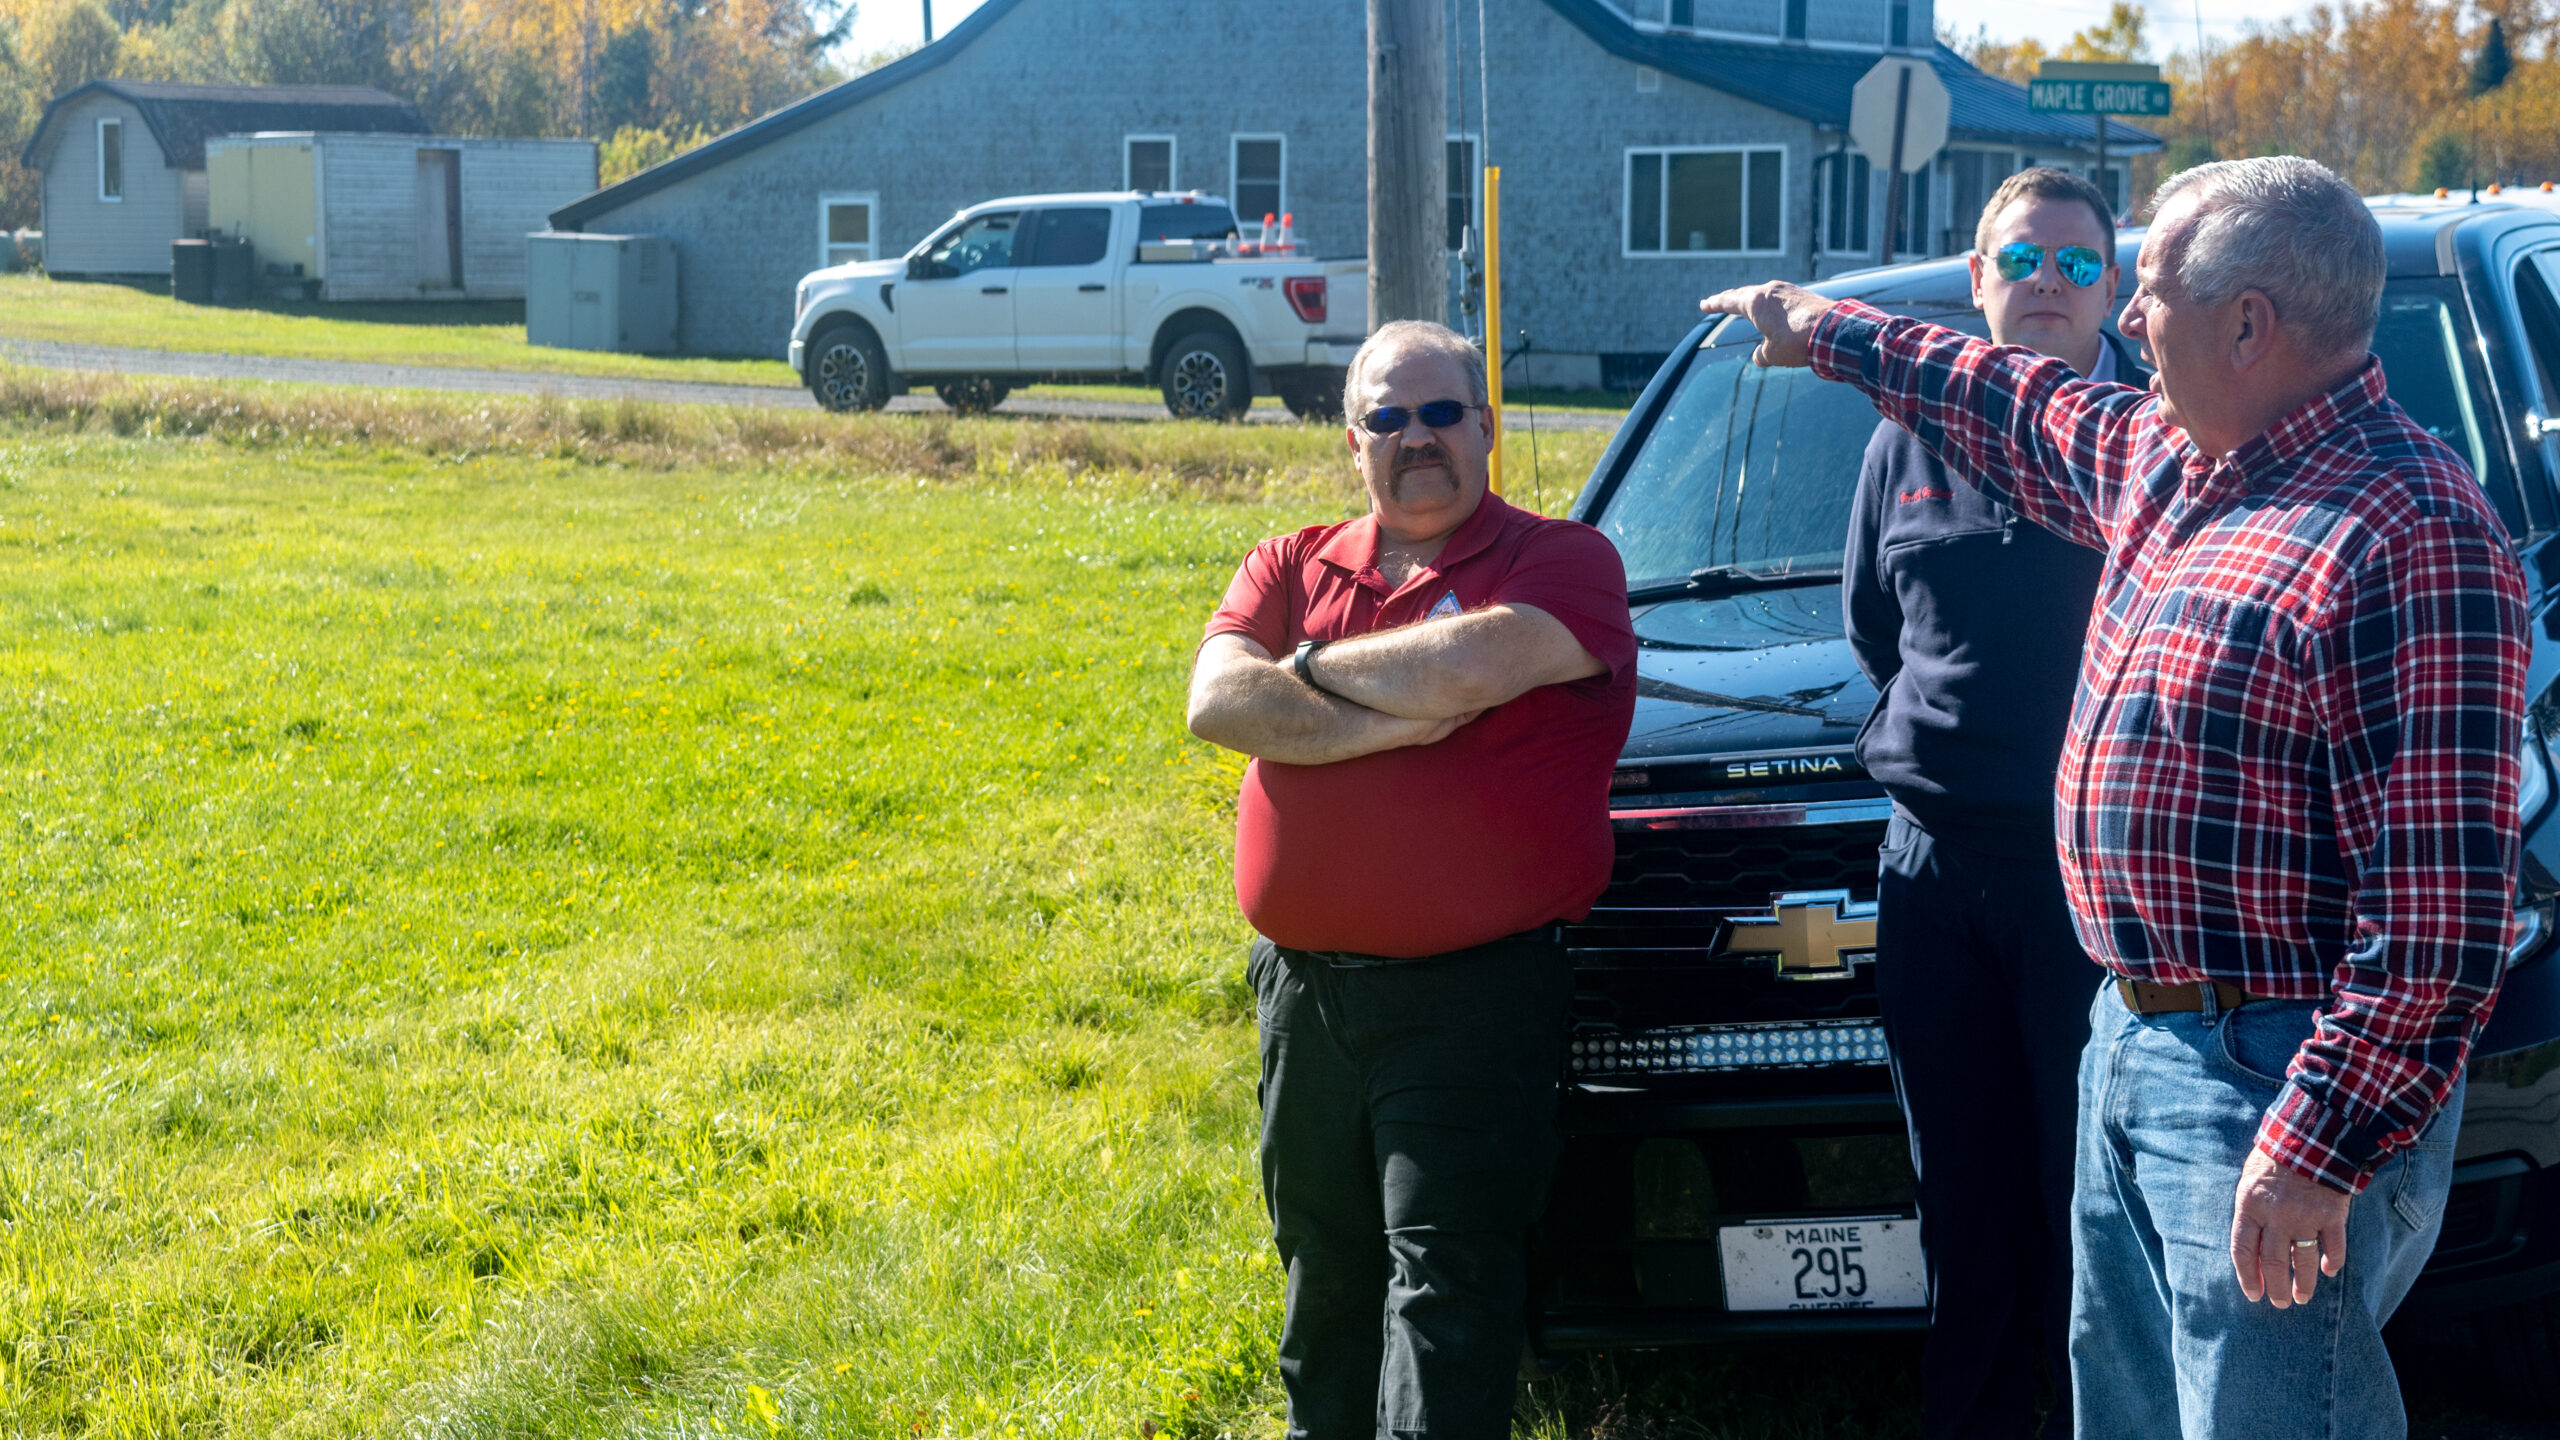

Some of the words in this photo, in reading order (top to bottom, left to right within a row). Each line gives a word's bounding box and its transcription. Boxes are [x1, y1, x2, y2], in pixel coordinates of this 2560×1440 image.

[2031, 82, 2085, 111] MAPLE
[2092, 83, 2149, 113] GROVE
[1726, 756, 1843, 779] SETINA
[1785, 1226, 1861, 1244] MAINE
[1791, 1246, 1868, 1299] 295
